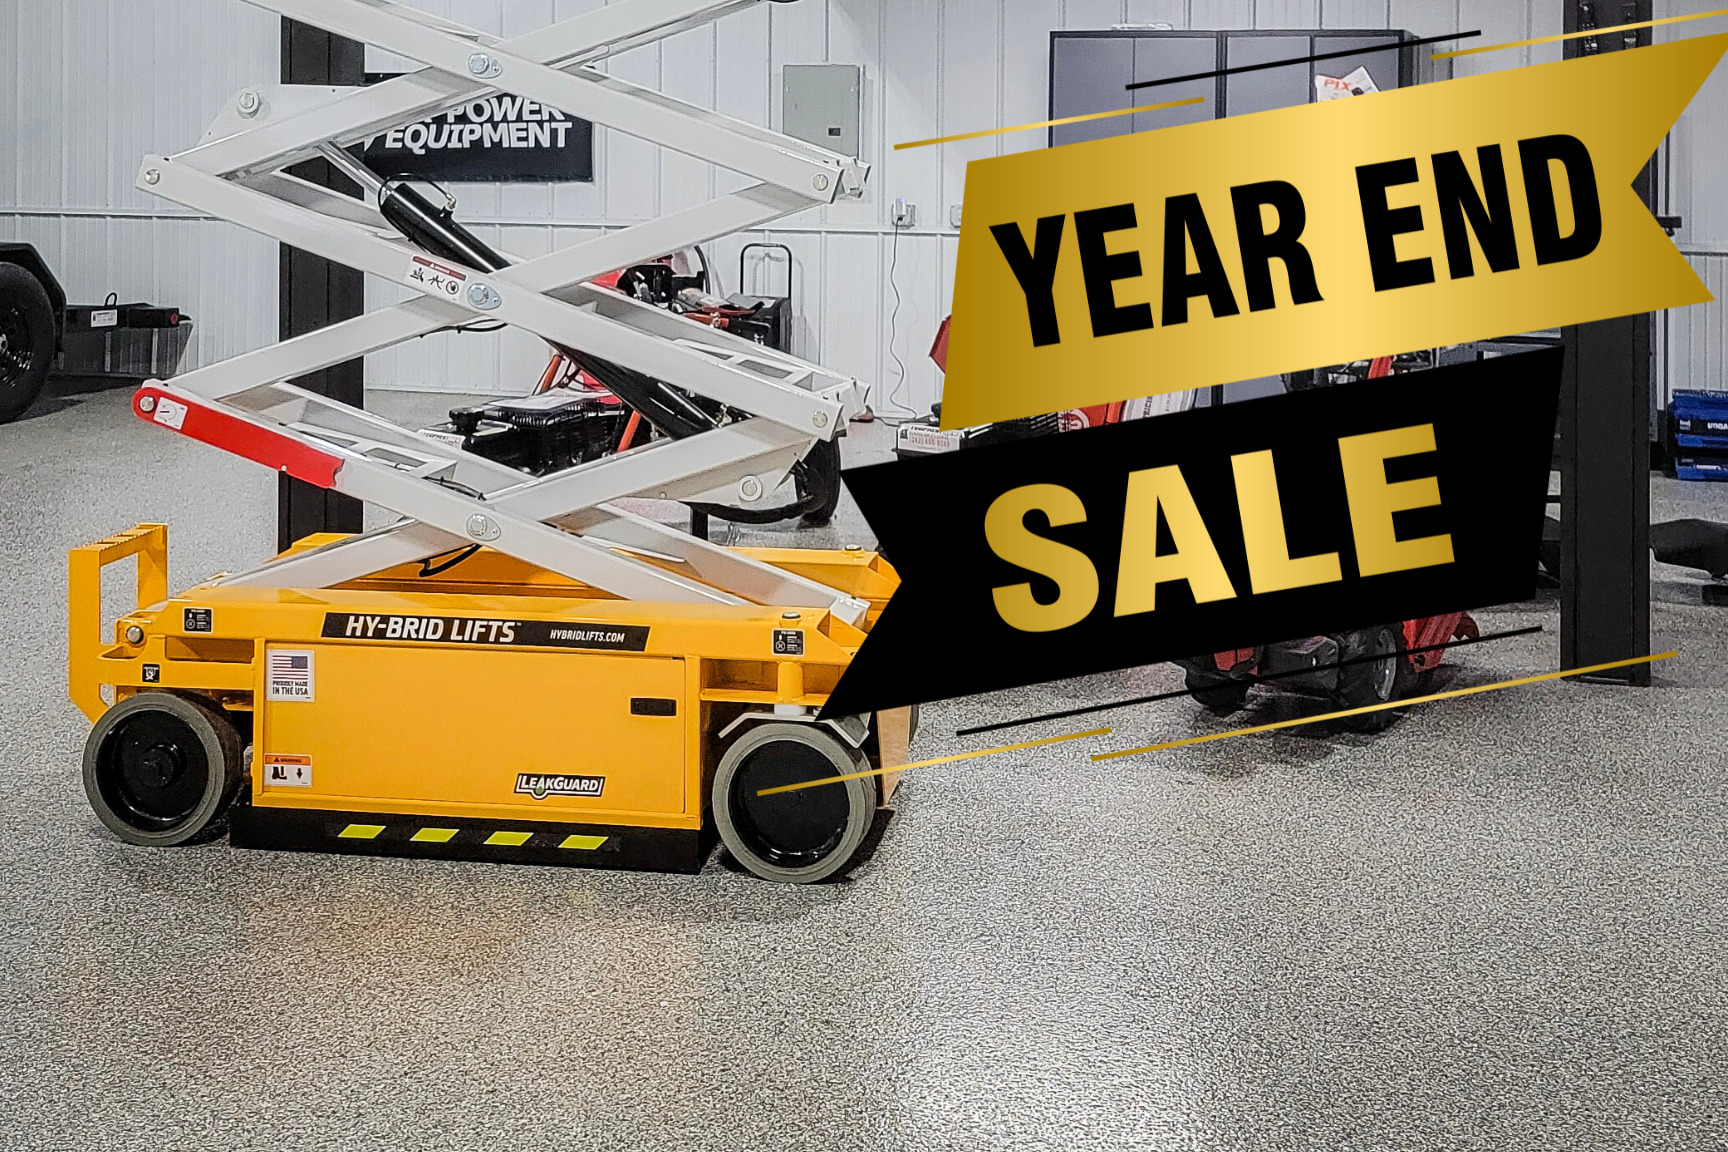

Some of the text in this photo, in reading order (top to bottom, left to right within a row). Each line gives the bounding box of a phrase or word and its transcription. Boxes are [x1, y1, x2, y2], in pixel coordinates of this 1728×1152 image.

[385, 122, 573, 155] EQUIPMENT
[345, 615, 444, 640] HY-BRID
[550, 629, 625, 643] HYBRIDLIFTS.COM
[272, 687, 309, 695] IN THE USA
